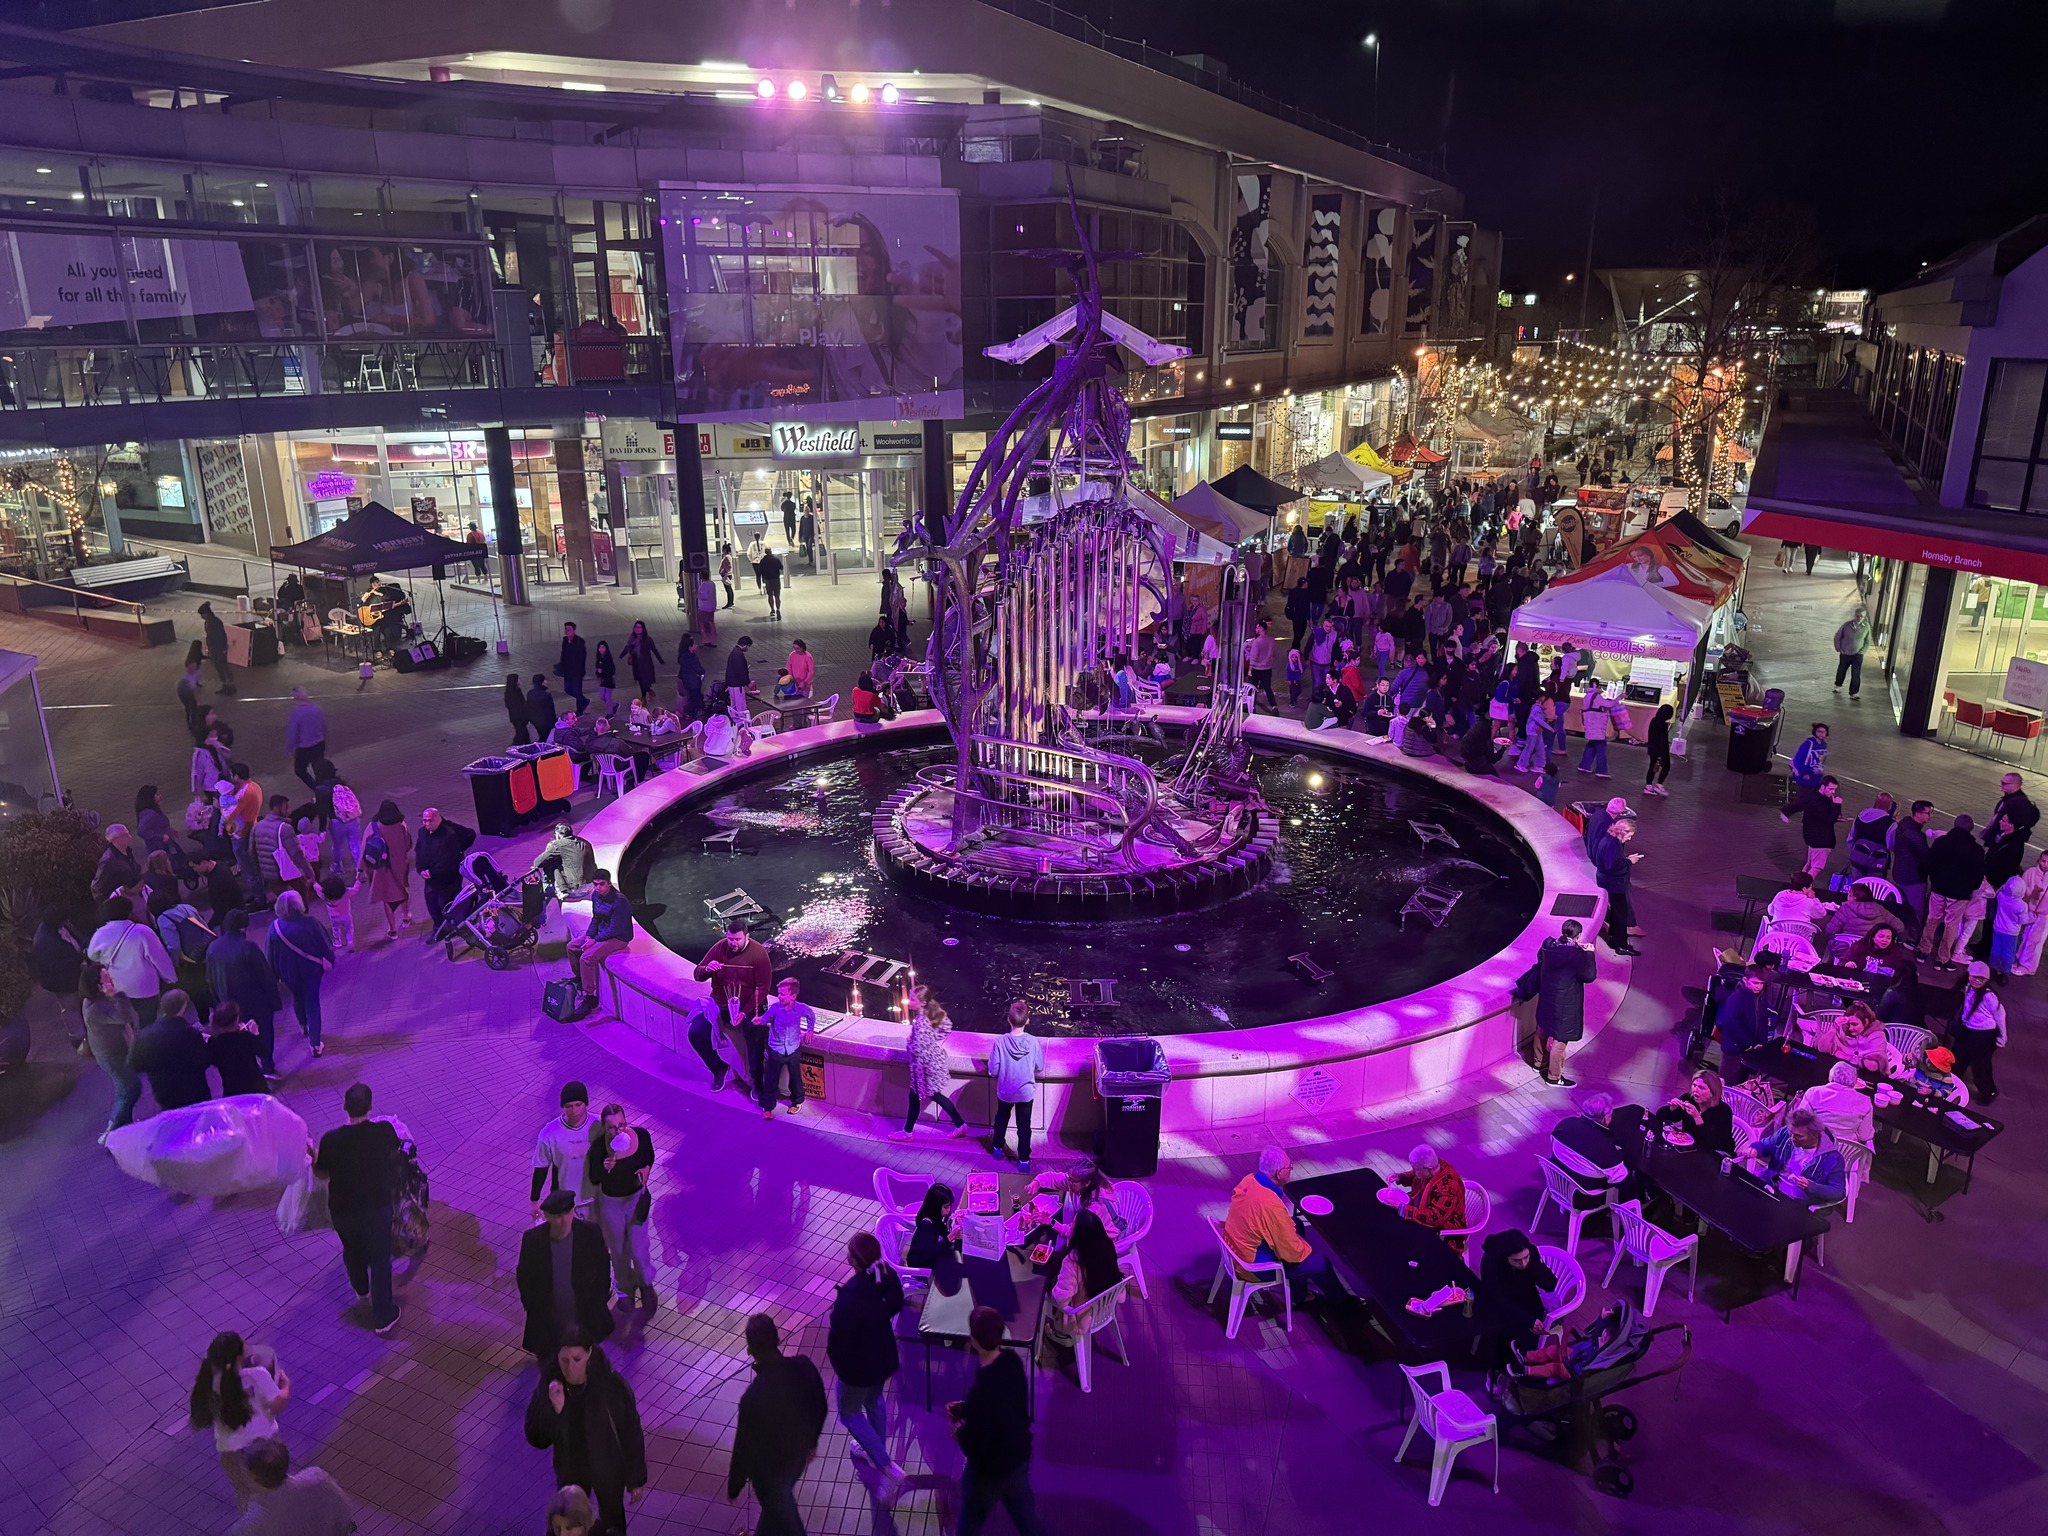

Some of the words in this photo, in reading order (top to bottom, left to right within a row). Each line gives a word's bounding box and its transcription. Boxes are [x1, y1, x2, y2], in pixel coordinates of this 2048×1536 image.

[67, 262, 86, 278] All
[90, 266, 118, 281] you
[126, 265, 163, 280] need
[58, 287, 80, 303] for
[84, 287, 103, 303] all
[139, 288, 187, 306] family
[897, 401, 941, 418] Westfield
[775, 425, 858, 454] Westfield
[875, 438, 911, 446] Woolworths
[633, 446, 657, 454] JONES
[372, 535, 425, 550] HORNSBY
[1922, 549, 1953, 564] Hornsby
[1954, 555, 1982, 568] Branch
[1531, 629, 1564, 642] Baked
[1565, 633, 1588, 645] Box
[1589, 637, 1646, 653] COOKIES
